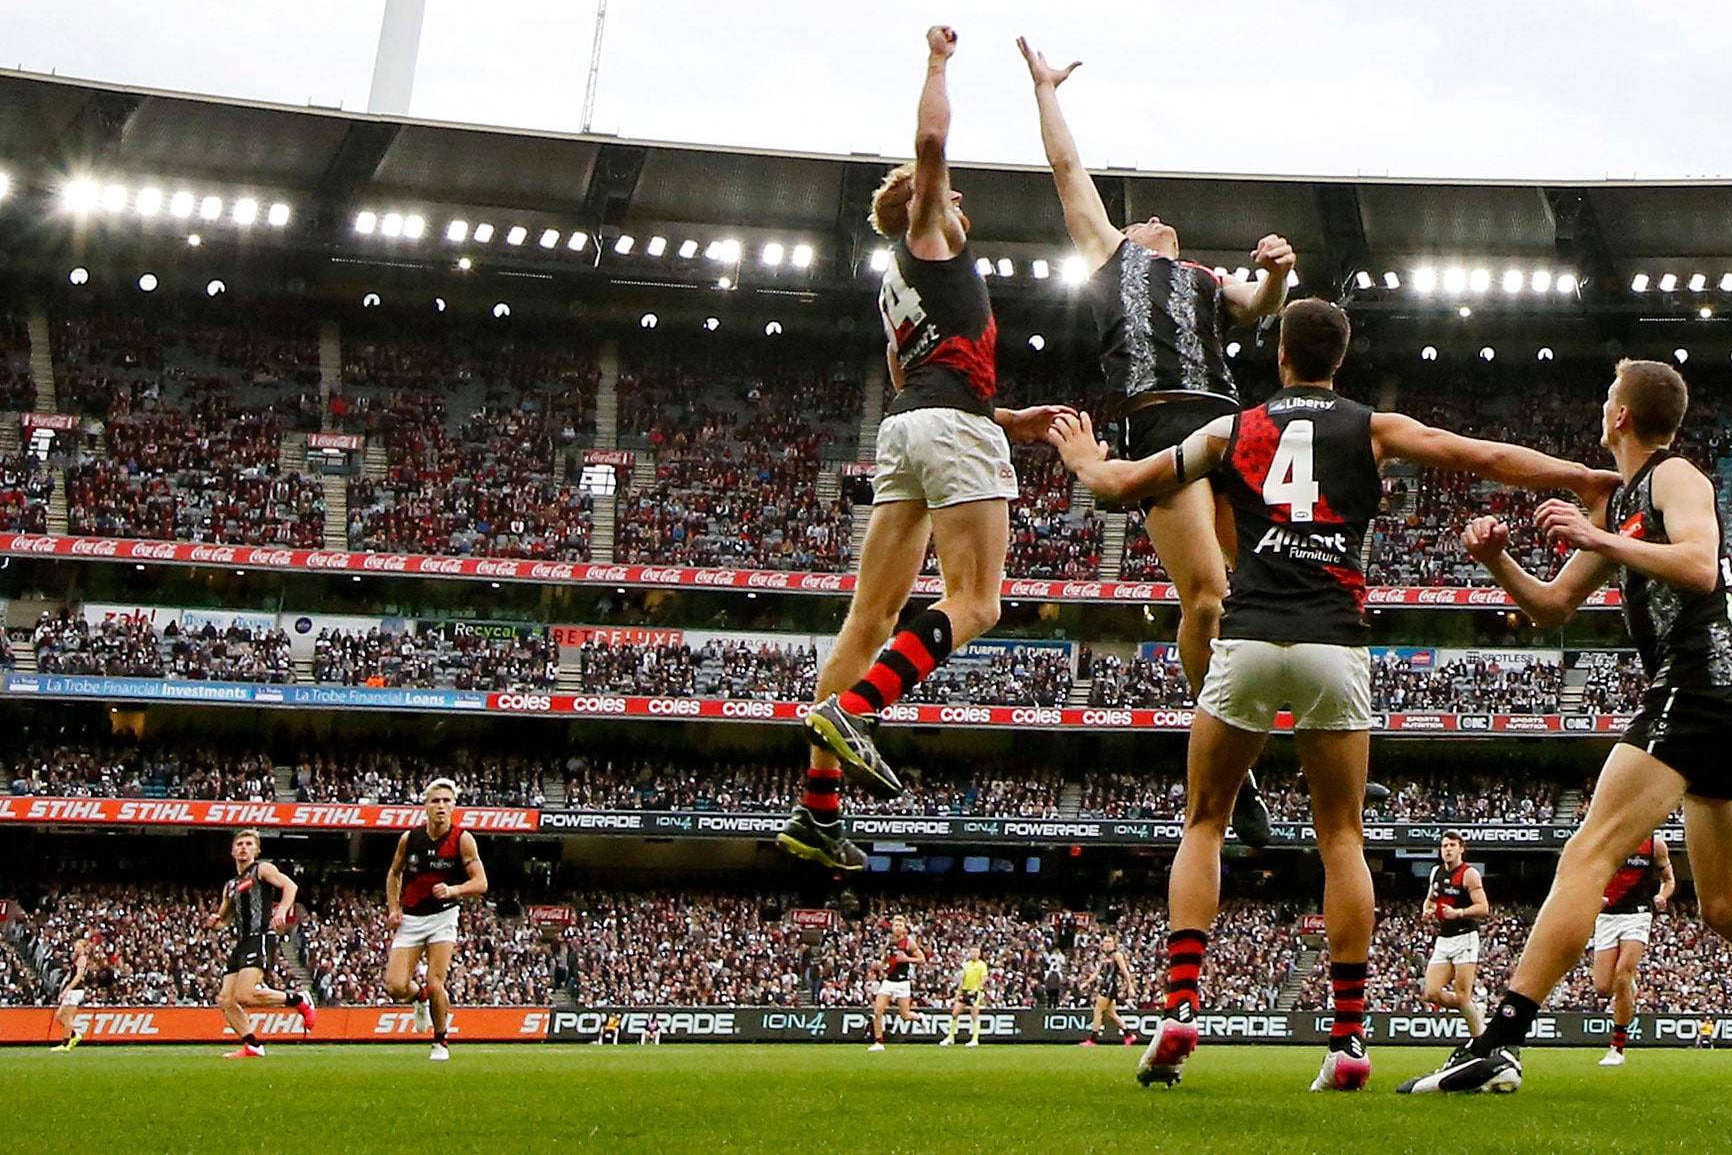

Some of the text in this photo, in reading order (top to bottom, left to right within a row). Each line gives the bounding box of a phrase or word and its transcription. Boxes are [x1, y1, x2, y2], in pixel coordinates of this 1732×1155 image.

[1286, 397, 1335, 410] Liberty
[1263, 419, 1319, 523] 4
[1289, 548, 1341, 564] Furniture
[47, 676, 248, 699] La Trobe Financial Investments
[294, 685, 445, 706] La Trobe Financial Loans
[498, 694, 553, 710] coles
[574, 697, 625, 712] coles
[649, 699, 700, 714] coles
[723, 701, 776, 717] coles
[941, 708, 990, 726] coles
[1012, 709, 1063, 725] coles
[1083, 711, 1132, 725] coles
[1154, 712, 1197, 726] cole
[28, 798, 107, 819] STIHL
[117, 800, 195, 821] STIHL
[205, 802, 280, 823] STIHL
[292, 804, 371, 824] STIHL
[458, 807, 531, 828] STIHL
[72, 1014, 159, 1034] STIHL
